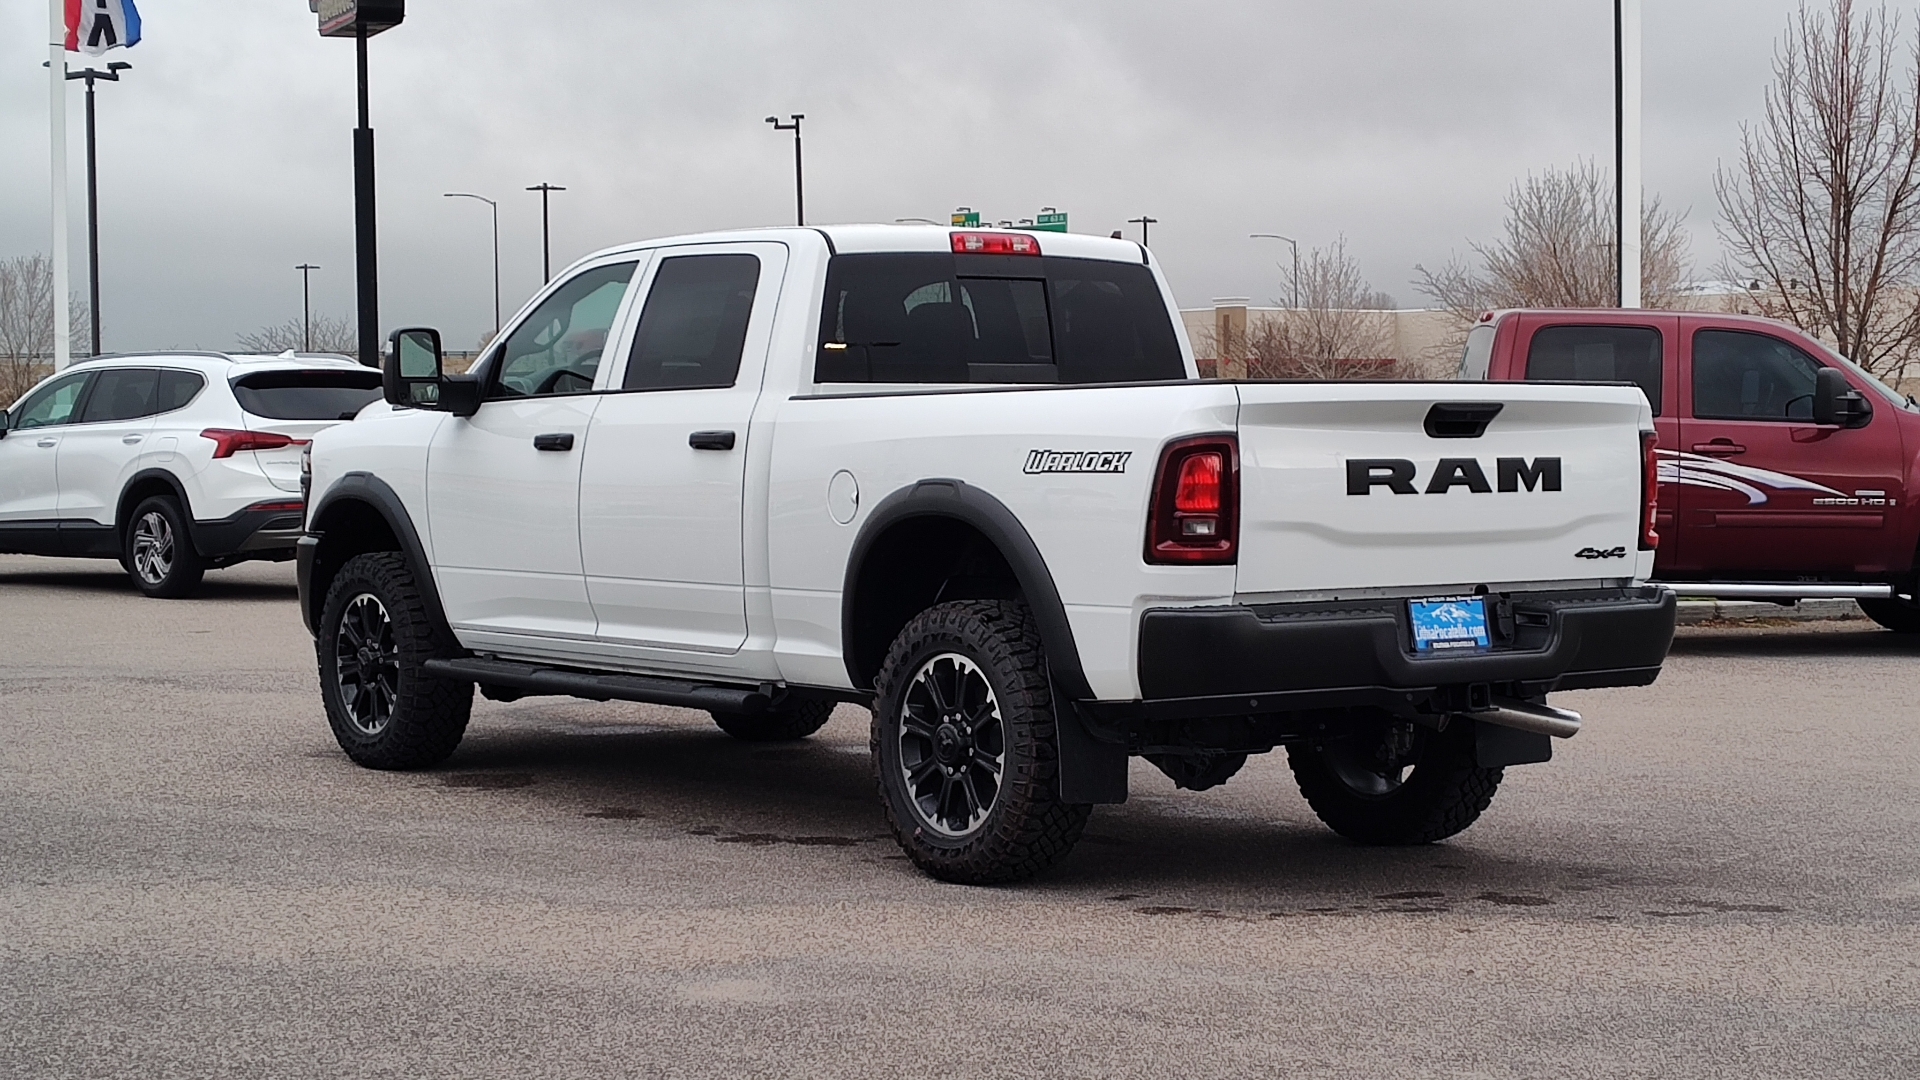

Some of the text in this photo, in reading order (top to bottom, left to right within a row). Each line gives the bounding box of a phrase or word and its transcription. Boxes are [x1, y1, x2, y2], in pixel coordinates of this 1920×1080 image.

[1022, 449, 1133, 474] WARLOCK
[1345, 456, 1563, 496] RAM
[1574, 546, 1627, 559] 4x4
